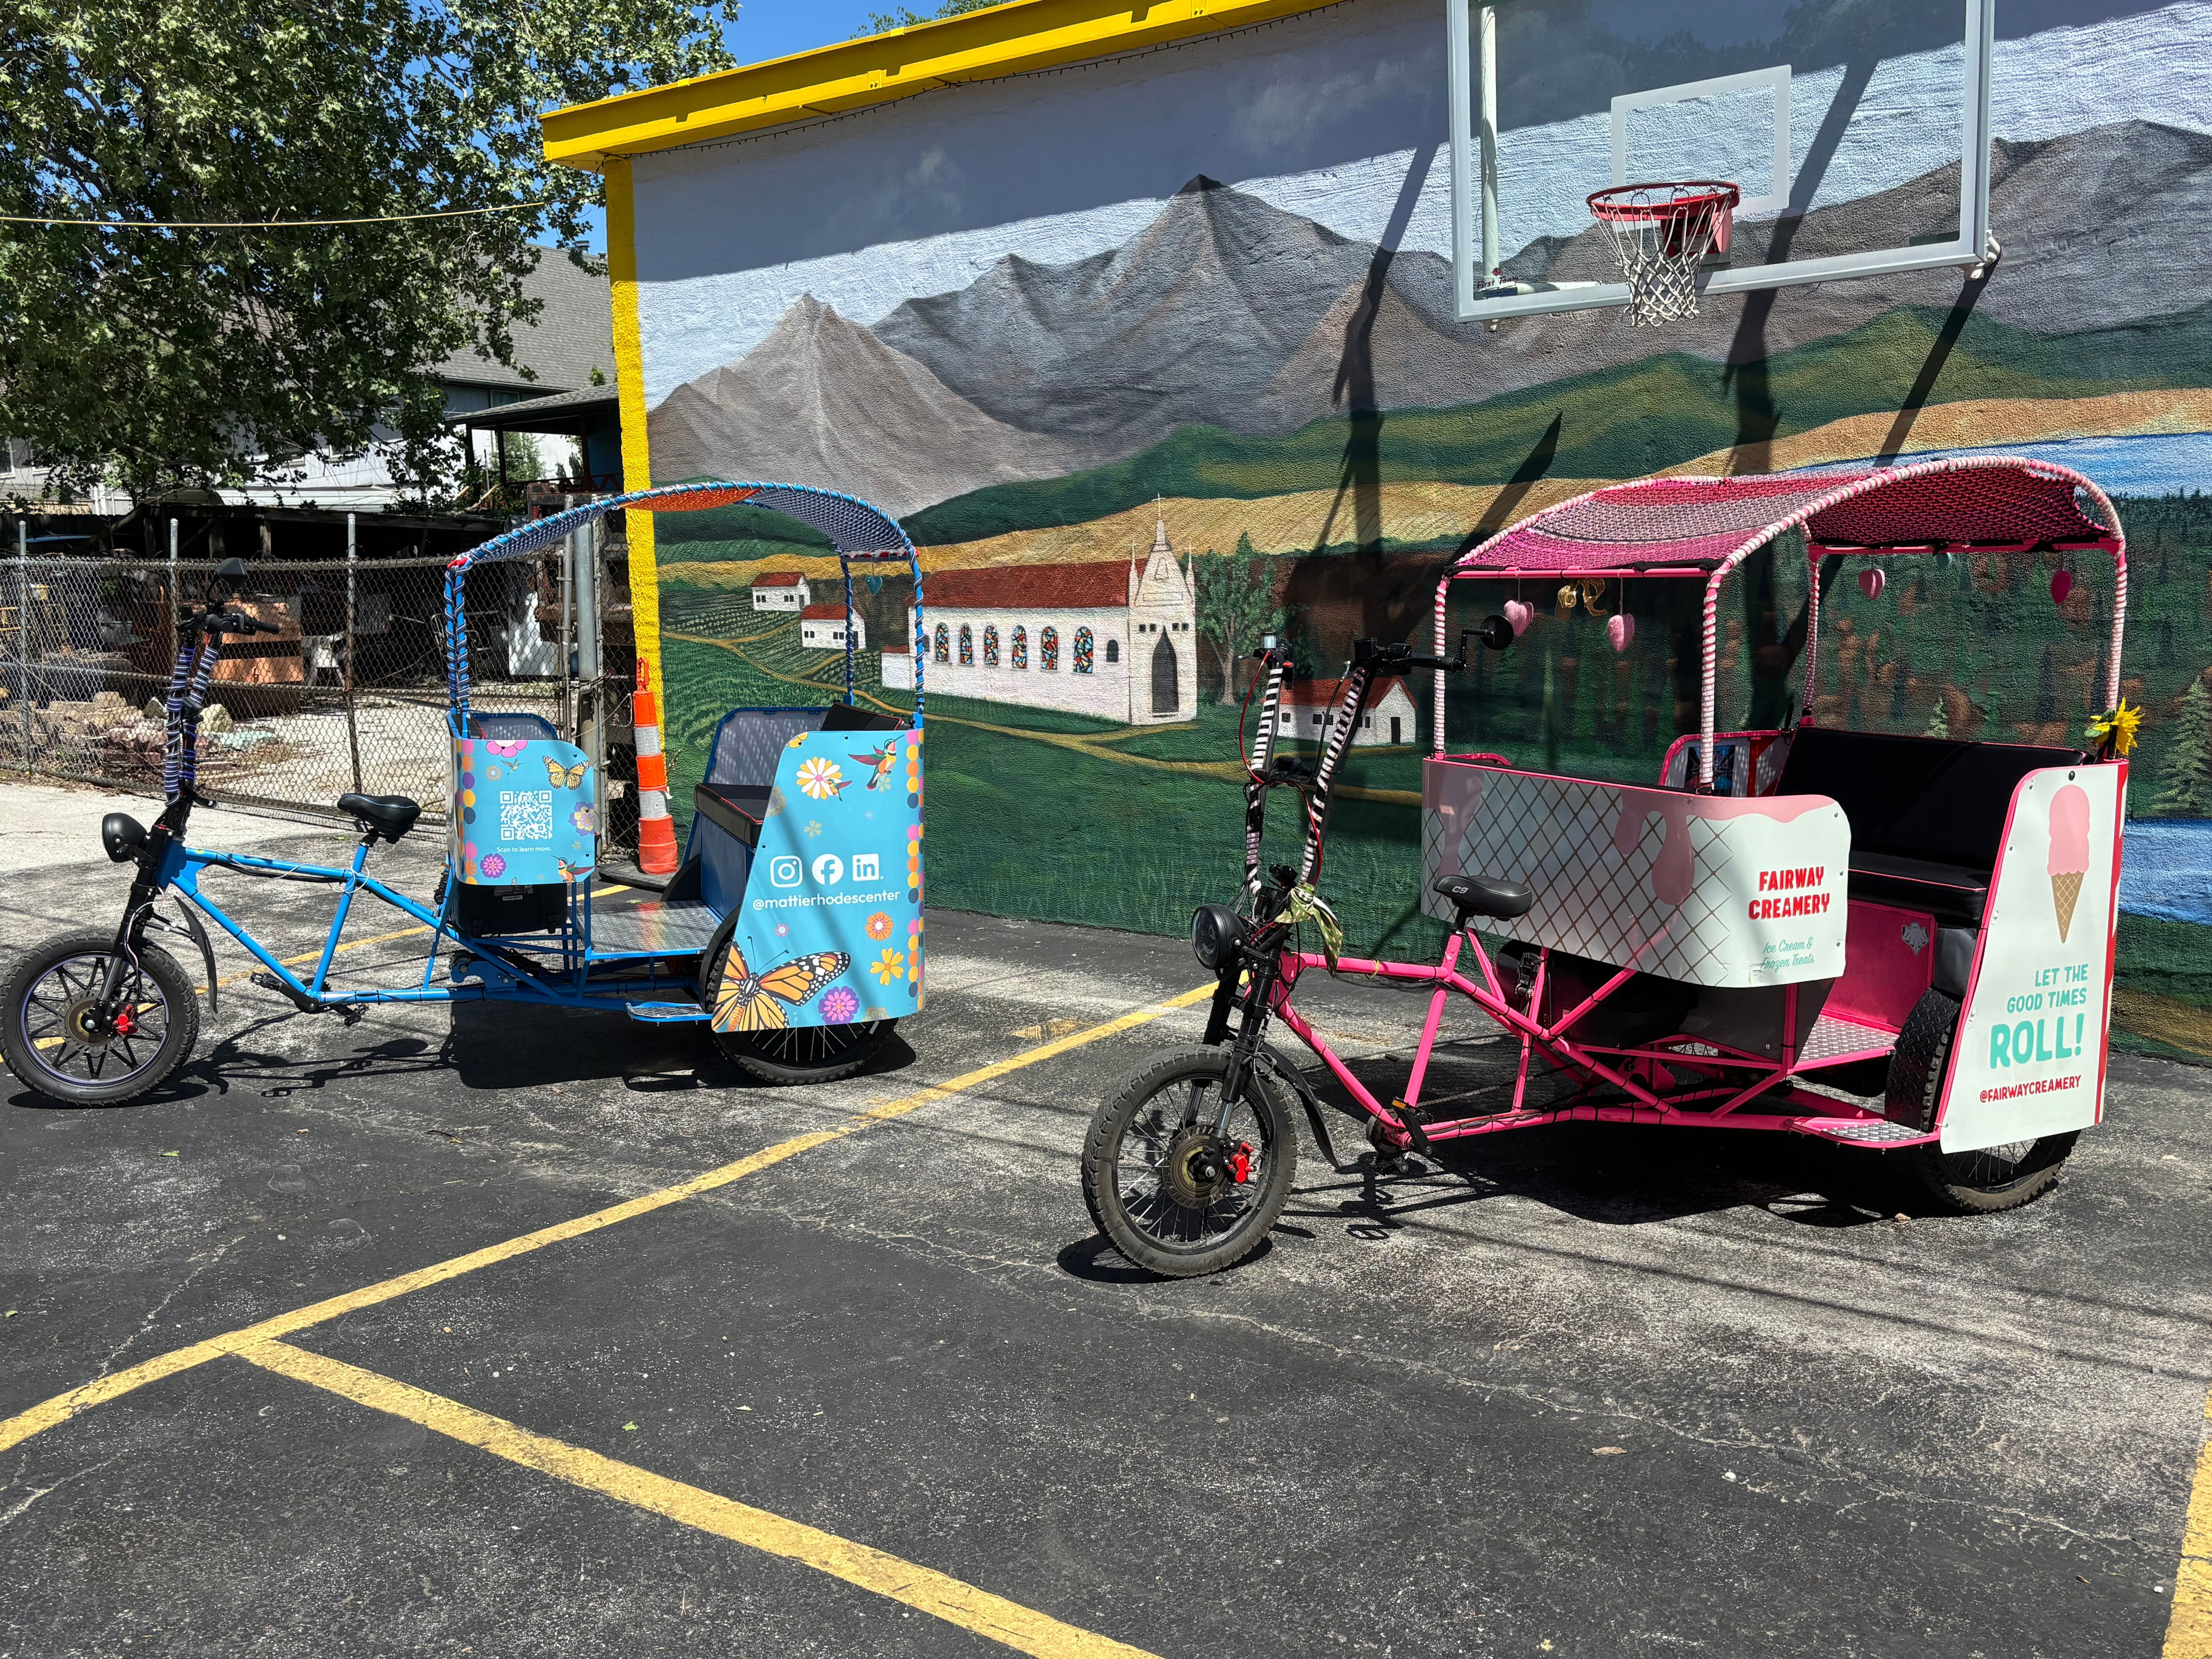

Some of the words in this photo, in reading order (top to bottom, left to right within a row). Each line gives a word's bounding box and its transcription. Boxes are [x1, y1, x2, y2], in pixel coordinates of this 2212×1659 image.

[1452, 885, 1469, 894] C9
[1758, 866, 1824, 892] FAIRWAY
[753, 889, 900, 910] @mattierhodescenter
[1748, 893, 1830, 920] CREAMERY
[1763, 941, 1776, 954] Ice
[1779, 939, 1805, 952] Cream
[1806, 937, 1813, 948] &
[1760, 957, 1790, 973] Frozen
[1791, 953, 1815, 966] Treats
[2035, 968, 2060, 987] LET
[2064, 963, 2088, 983] THE
[2007, 993, 2043, 1014] GOOD
[2048, 987, 2086, 1008] TIMES
[1989, 1012, 2084, 1069] ROLL!
[1980, 1074, 2081, 1103] @FAIRWAYCREAMERY
